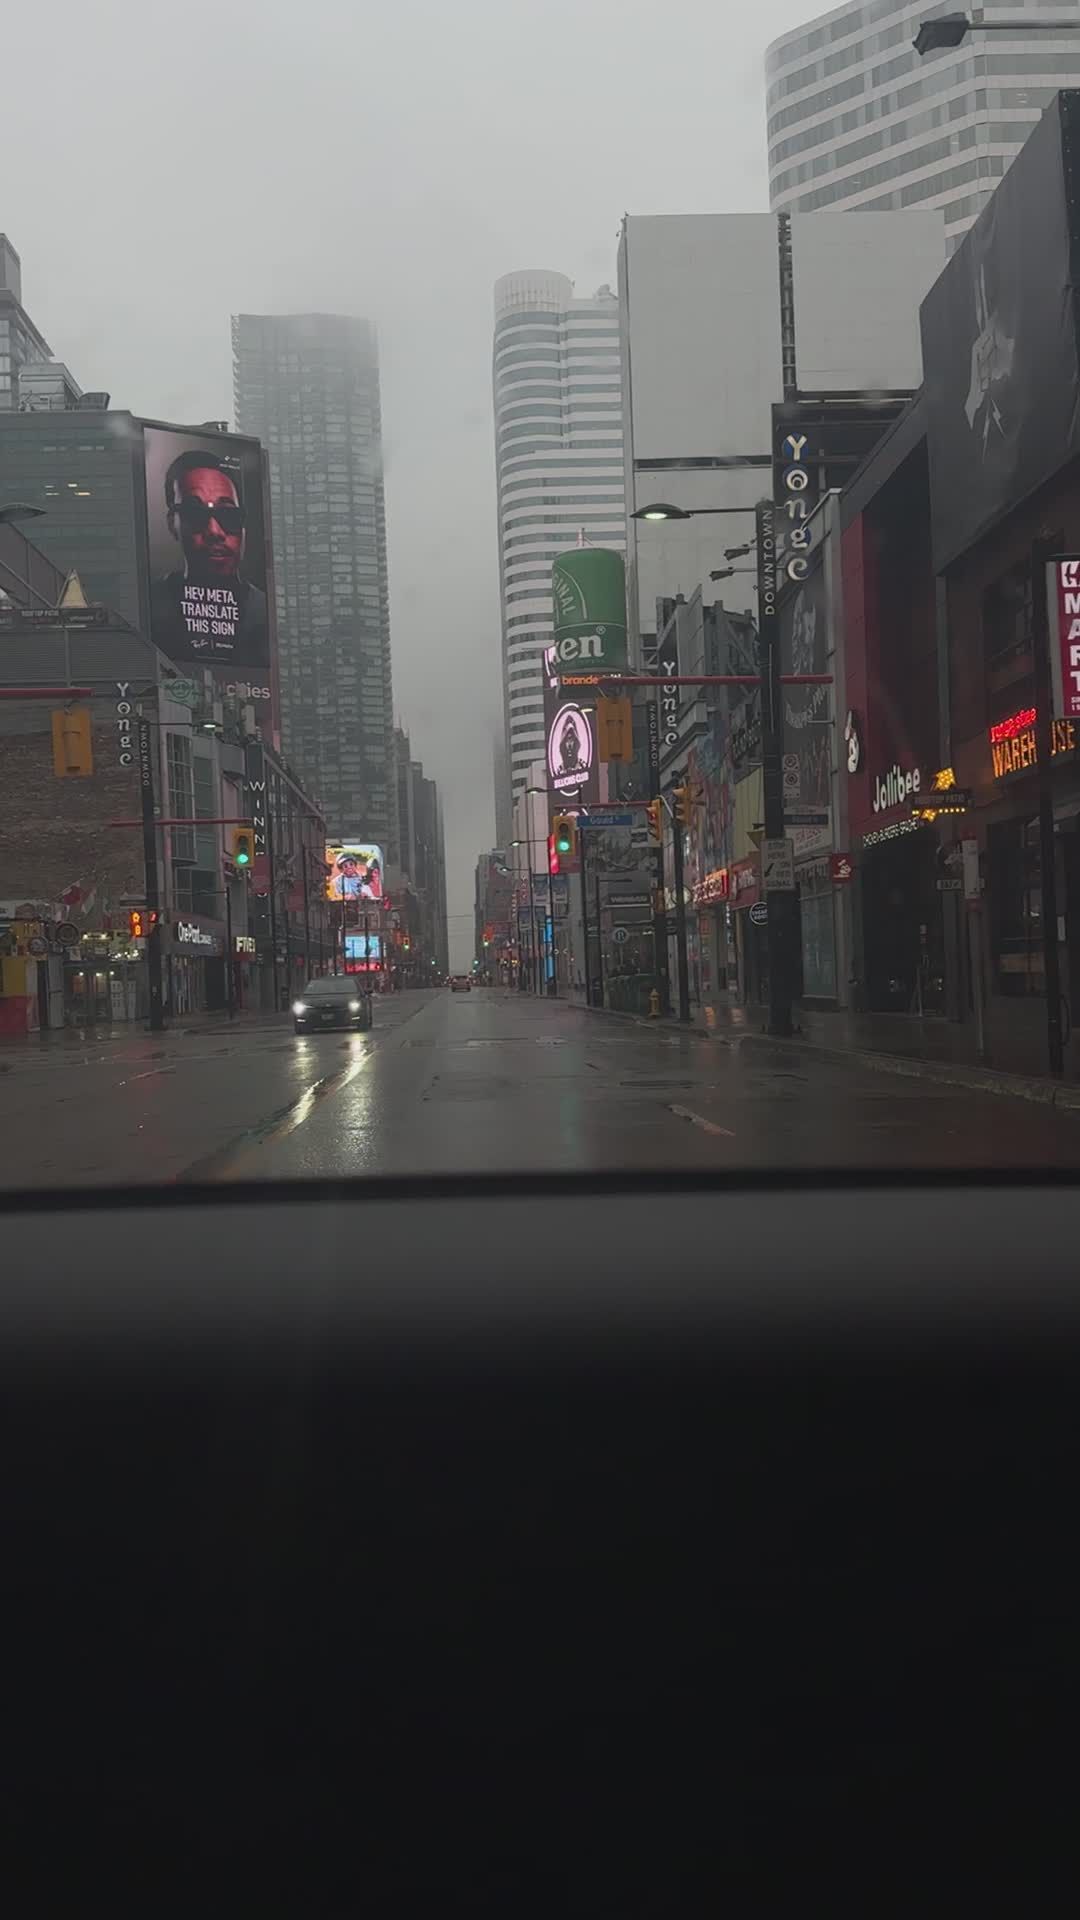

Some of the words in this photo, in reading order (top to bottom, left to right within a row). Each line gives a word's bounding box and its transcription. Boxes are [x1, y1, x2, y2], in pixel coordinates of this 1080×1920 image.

[785, 434, 809, 581] Yonge
[762, 509, 776, 616] DOWNTOWN
[180, 601, 240, 621] TRANSLATE
[184, 585, 205, 601] HEY
[206, 588, 238, 606] META,
[185, 617, 209, 634] THIS
[211, 620, 235, 636] SIGN
[226, 681, 272, 699] cies
[662, 660, 678, 746] Yonge
[116, 682, 133, 767] Yonge
[140, 724, 150, 786] DOWNTOWN
[649, 703, 658, 768] DOWNTOWN
[873, 764, 921, 813] Jollibee
